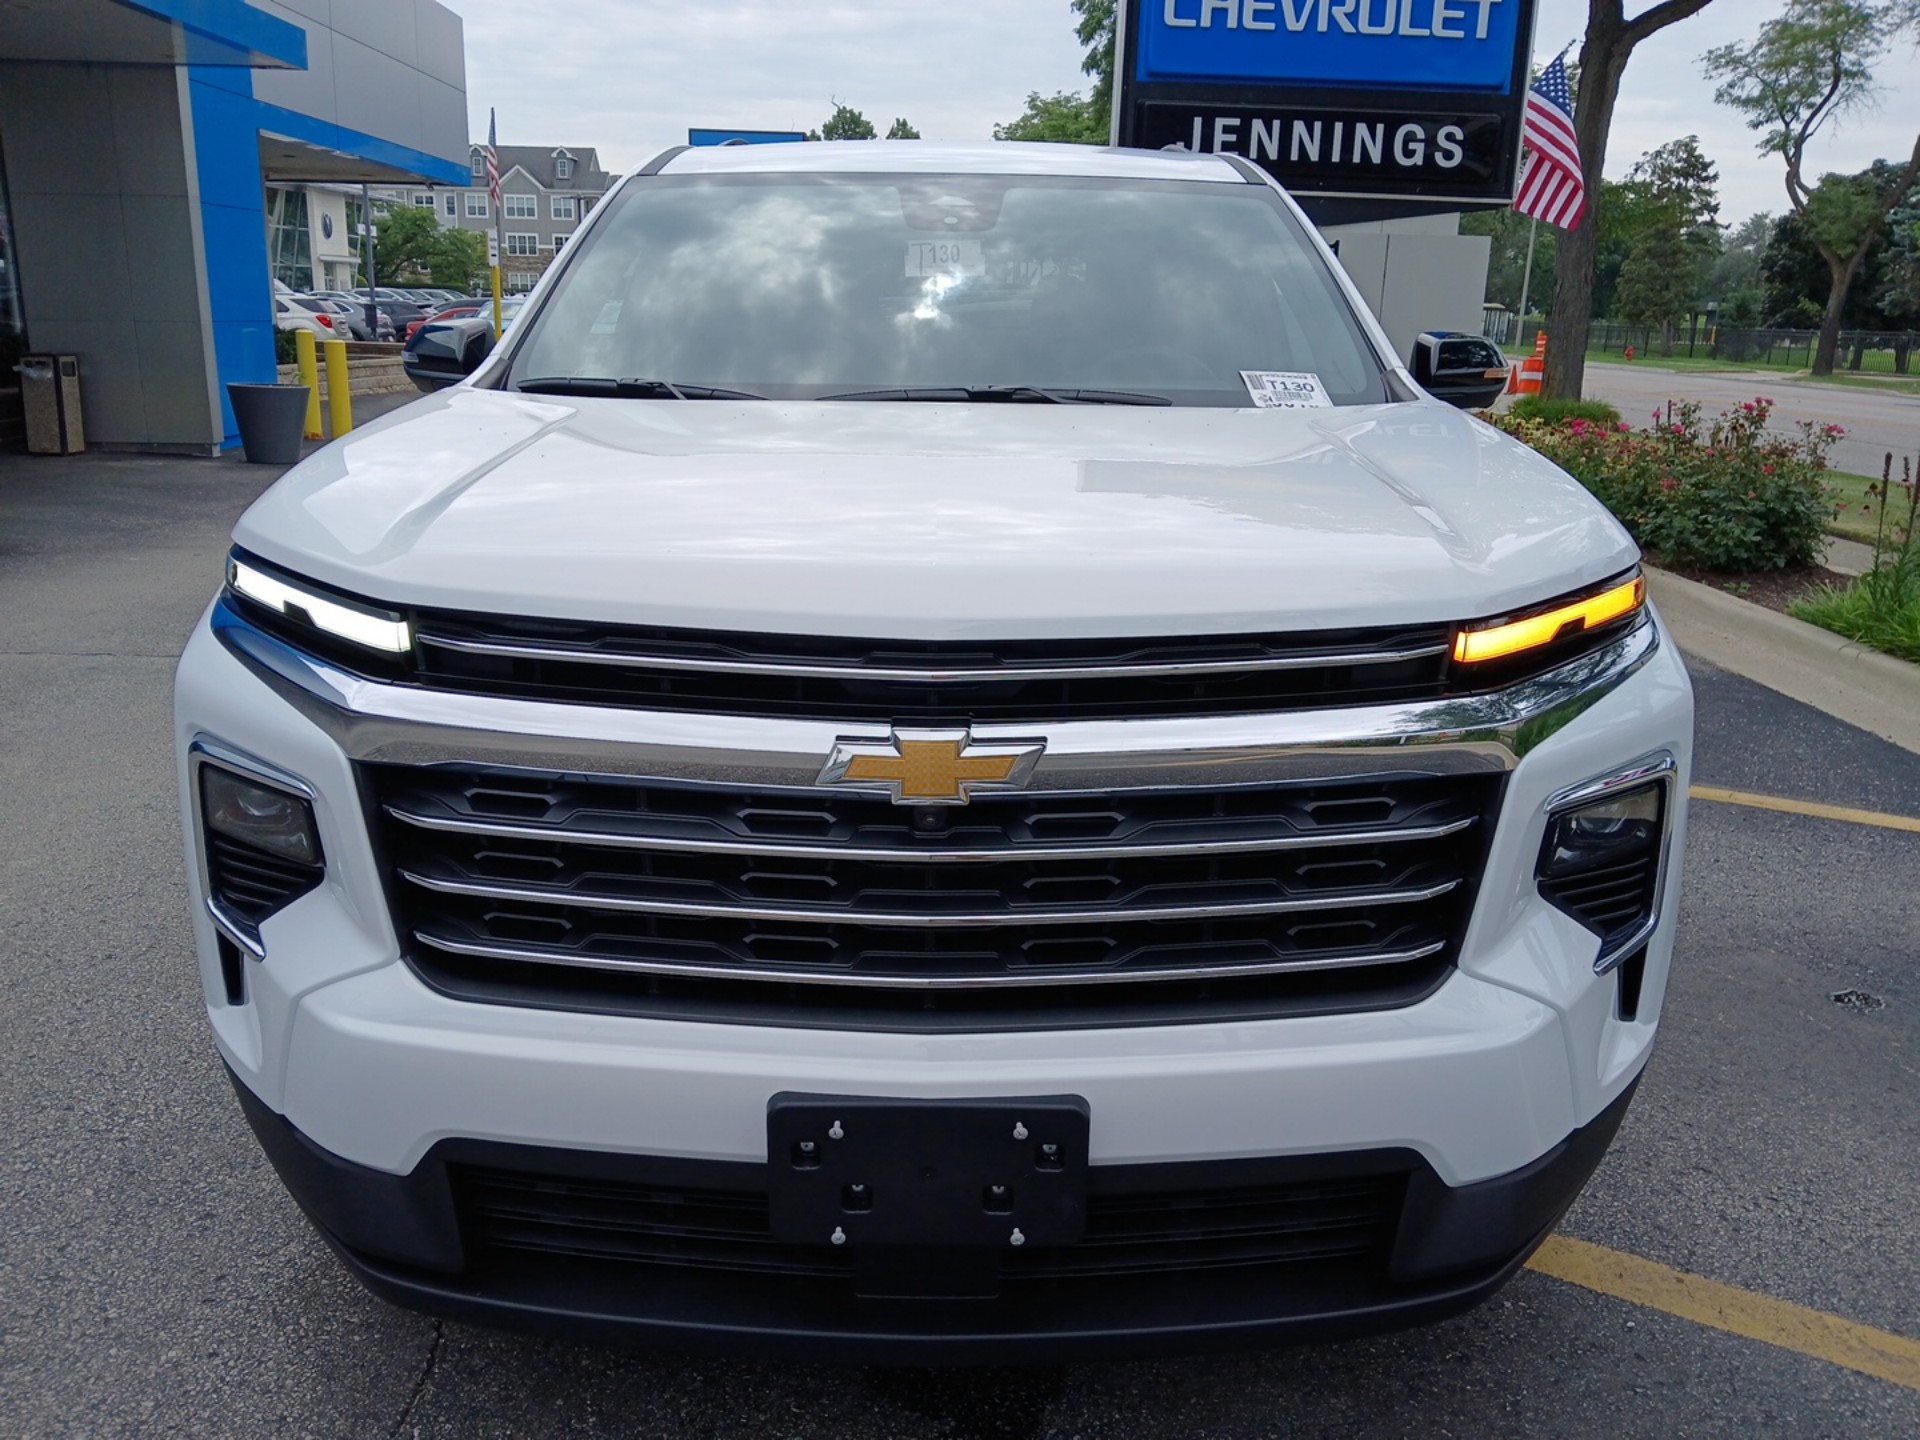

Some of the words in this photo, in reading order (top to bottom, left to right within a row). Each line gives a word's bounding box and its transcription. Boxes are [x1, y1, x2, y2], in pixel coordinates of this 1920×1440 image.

[1164, 0, 1501, 39] CHEVROLET
[1176, 116, 1464, 168] JENNINGS
[910, 242, 960, 275] T130
[1266, 379, 1315, 393] T130
